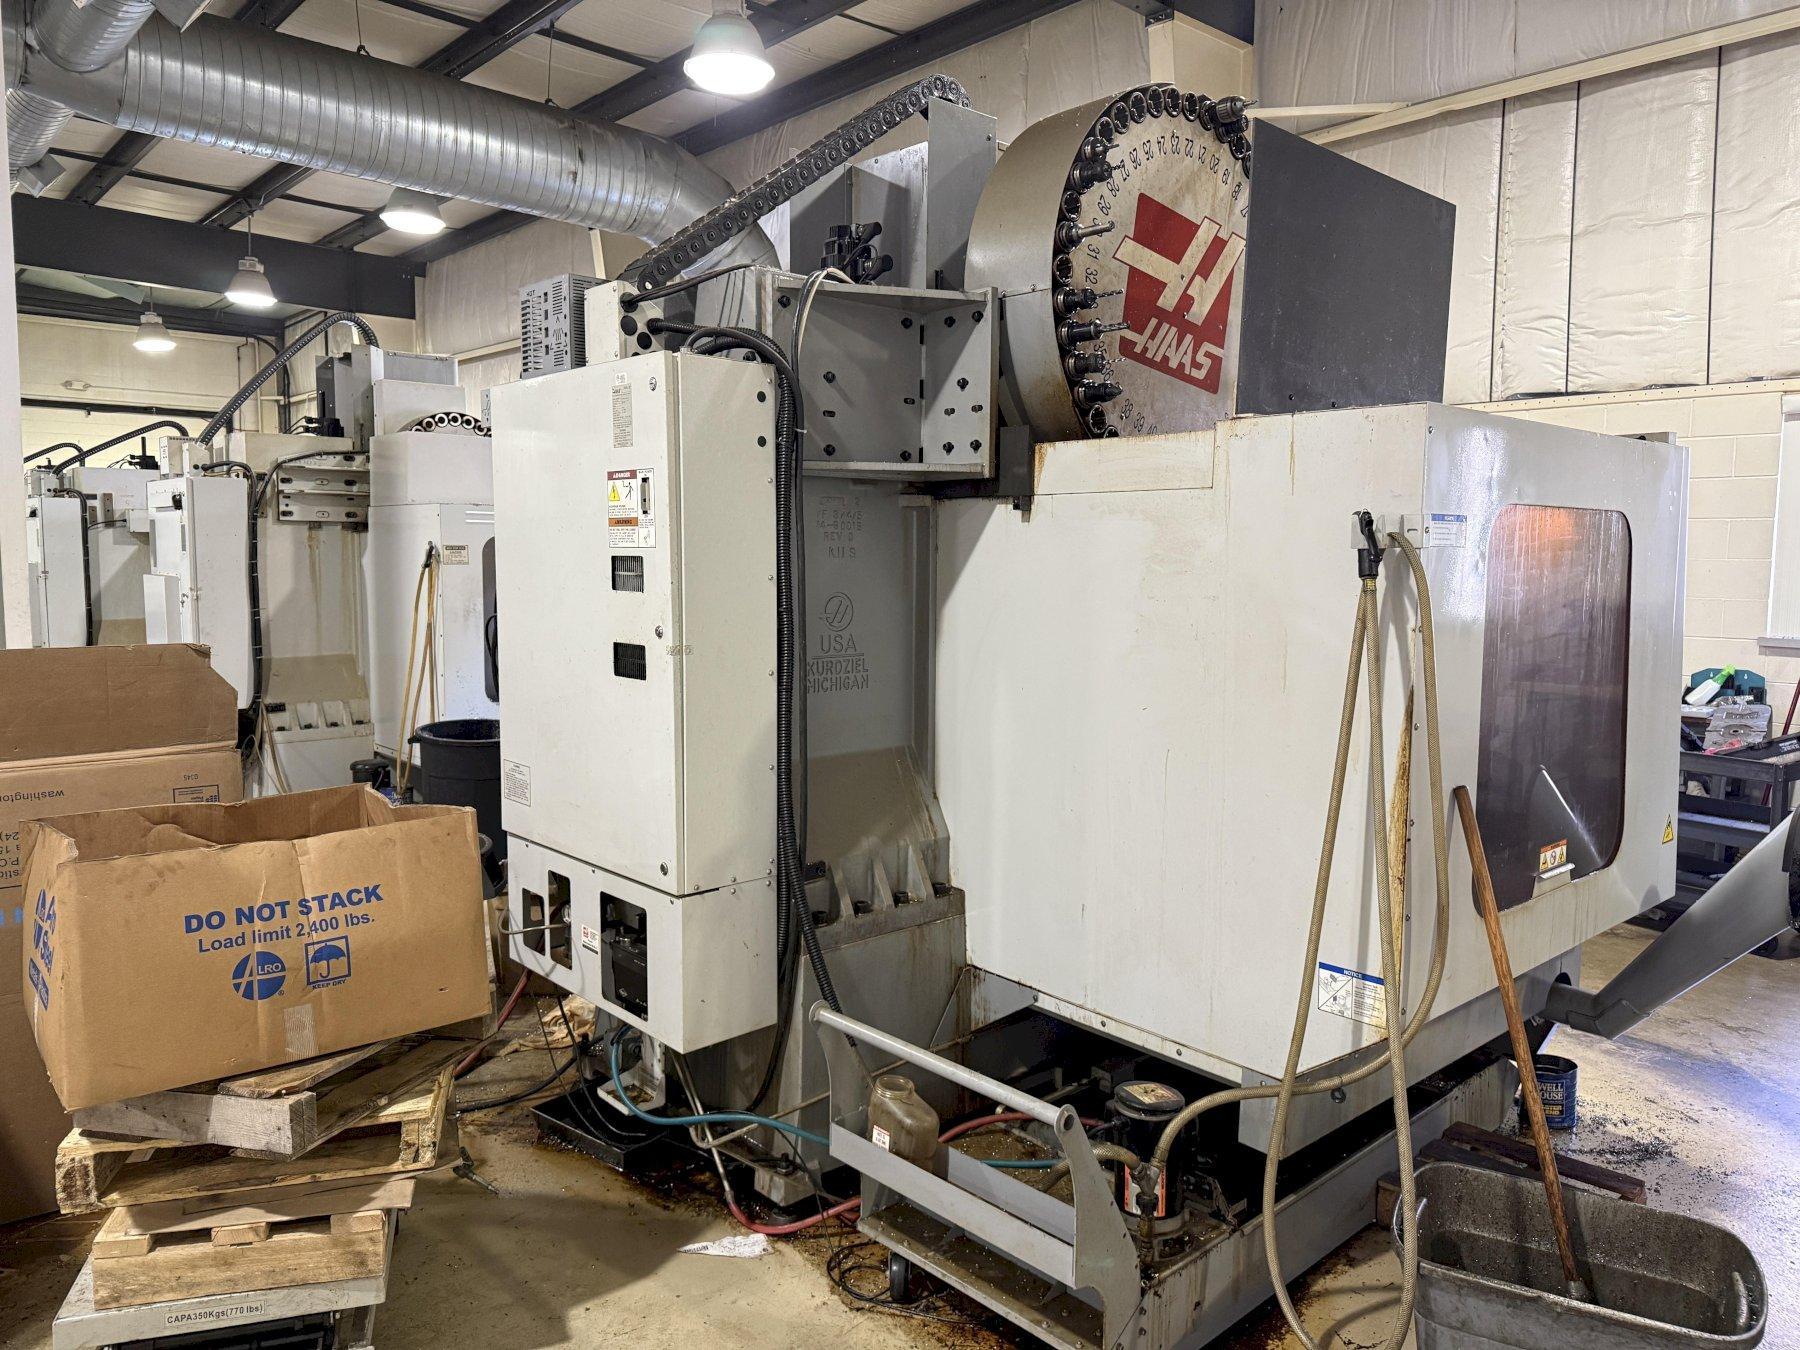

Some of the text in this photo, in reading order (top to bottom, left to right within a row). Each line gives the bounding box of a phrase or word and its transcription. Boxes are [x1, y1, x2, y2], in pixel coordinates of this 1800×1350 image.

[1142, 140, 1154, 161] 25
[1157, 136, 1167, 155] 24
[1185, 138, 1194, 158] 22
[1198, 144, 1207, 164] 21
[1130, 147, 1142, 170] 26
[1210, 154, 1220, 174] 20
[1119, 159, 1130, 182] 27
[1222, 168, 1231, 186] 19
[1106, 177, 1120, 198] 28
[1097, 194, 1112, 216] 29
[1087, 243, 1100, 260] 31
[1085, 267, 1098, 285] 32
[1119, 316, 1225, 380] HAAS
[1133, 412, 1146, 433] 39
[820, 633, 857, 655] USA
[807, 657, 869, 678] KURDZIEL
[807, 673, 869, 694] MICHIGAN
[184, 884, 384, 934] DO NOT STACK
[198, 912, 375, 953] Load limit 2,400 lbs.
[1343, 970, 1363, 978] NOTICE
[311, 979, 347, 991] KEEP DRY
[1537, 1083, 1564, 1092] WELL
[1540, 1091, 1564, 1100] OUSE
[246, 1304, 263, 1315] lbs)
